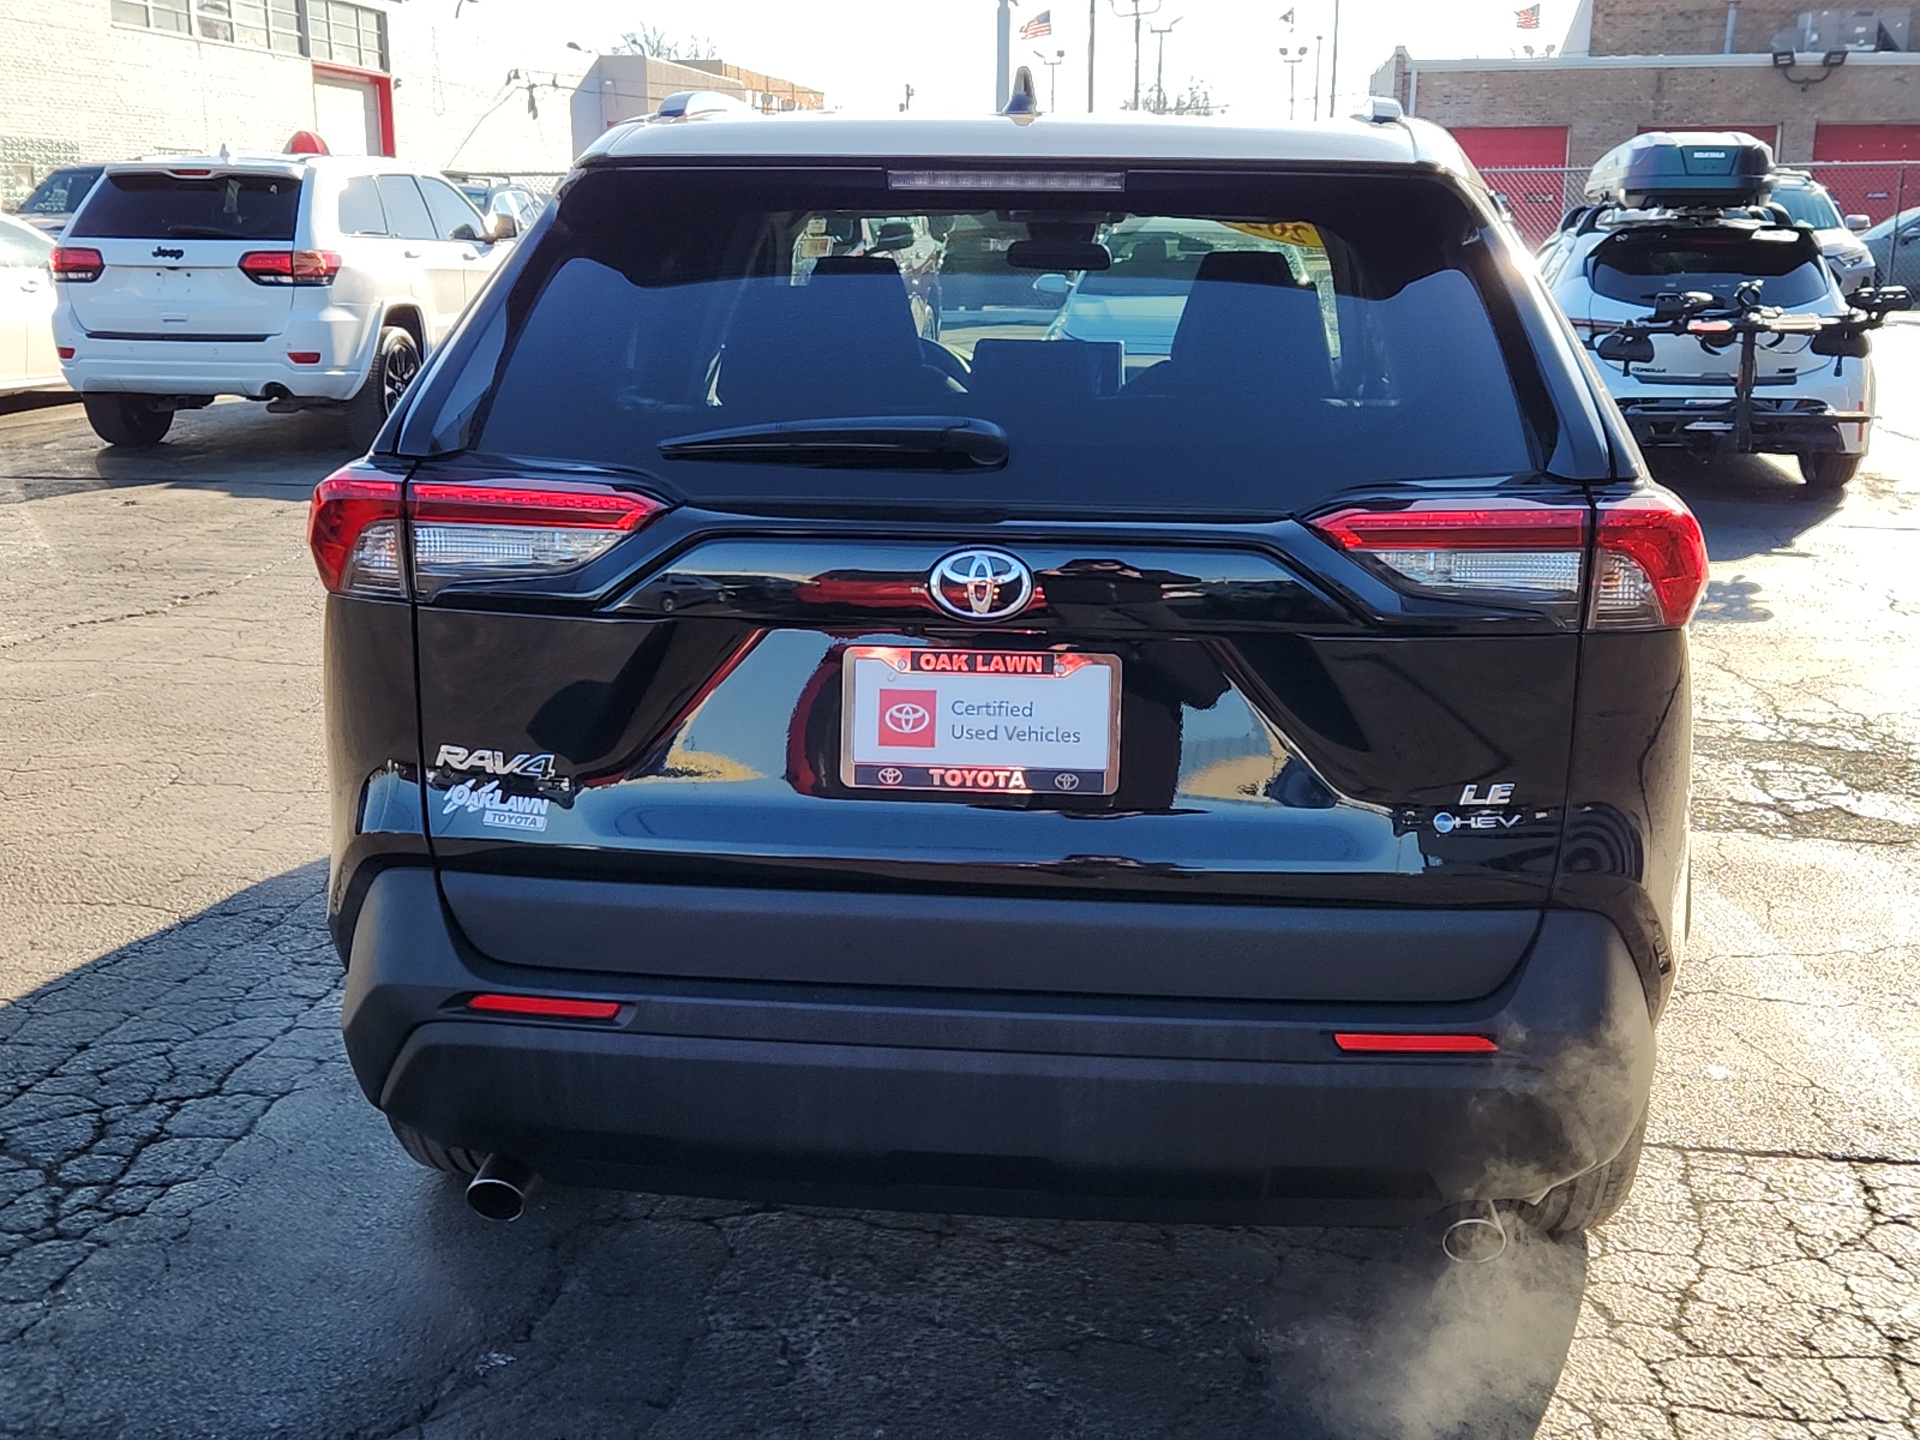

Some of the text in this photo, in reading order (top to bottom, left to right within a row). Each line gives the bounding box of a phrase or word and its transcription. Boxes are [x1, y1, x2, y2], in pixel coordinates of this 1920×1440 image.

[151, 245, 184, 260] Jeep
[919, 653, 1043, 673] OAK LAWN
[951, 700, 1034, 718] Certified
[951, 724, 1081, 744] Used Vehicles
[435, 744, 557, 780] RAV4
[928, 768, 1027, 790] TOYOTA
[1459, 782, 1516, 806] LE
[491, 812, 539, 828] TOYOTA
[1453, 814, 1523, 829] HEV
